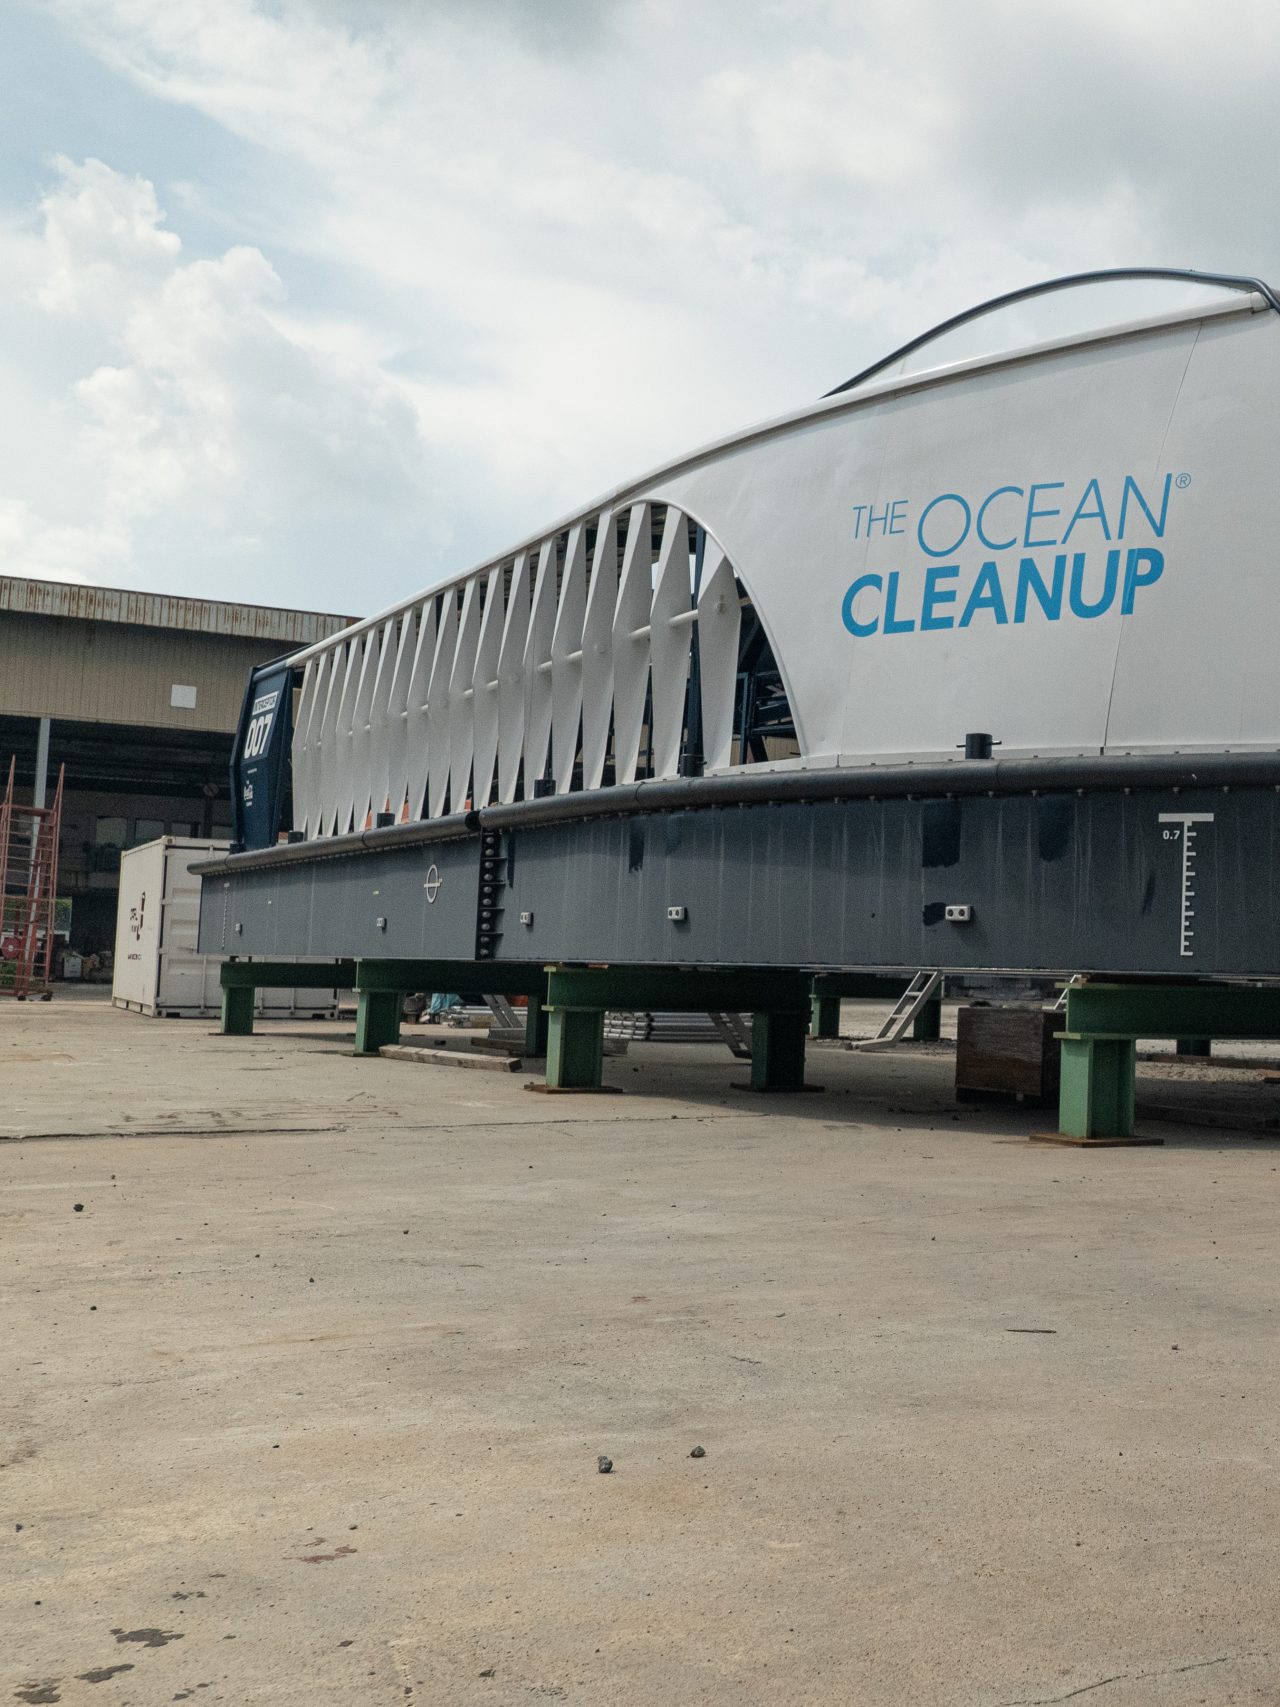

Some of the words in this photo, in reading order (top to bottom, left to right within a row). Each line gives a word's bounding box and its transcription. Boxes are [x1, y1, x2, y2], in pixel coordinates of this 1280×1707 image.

[852, 500, 909, 539] THE
[841, 547, 1165, 638] CLEANUP
[244, 713, 274, 759] 007
[1163, 830, 1180, 840] 0.7
